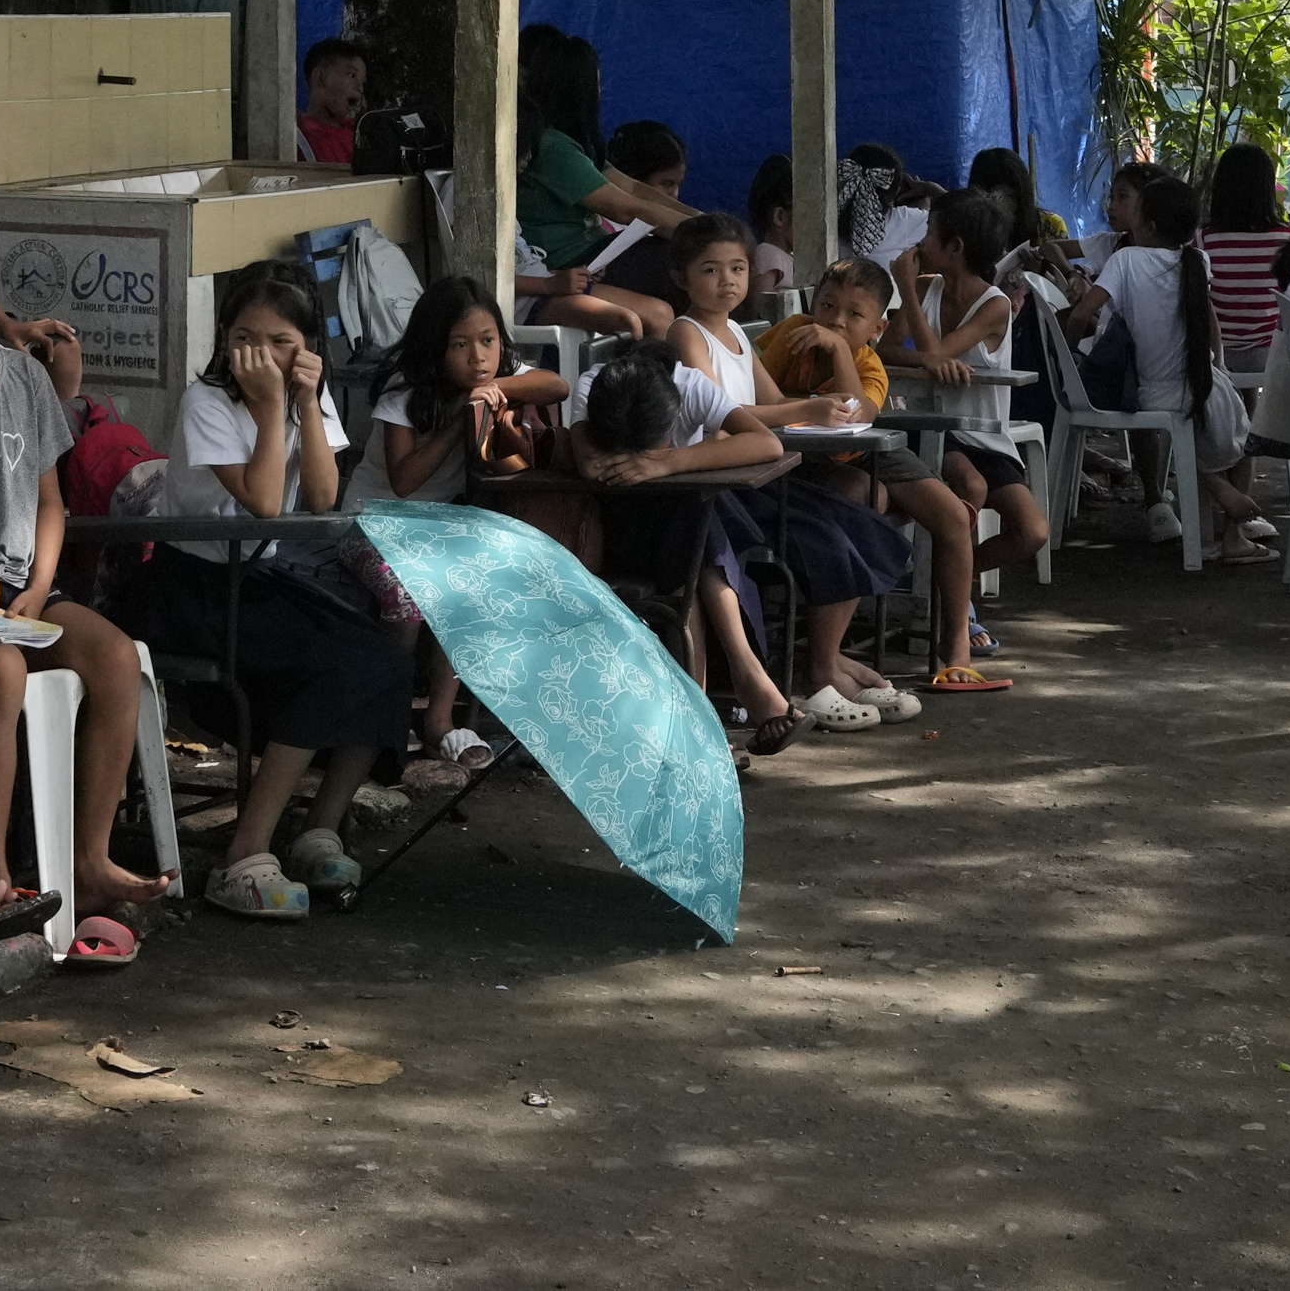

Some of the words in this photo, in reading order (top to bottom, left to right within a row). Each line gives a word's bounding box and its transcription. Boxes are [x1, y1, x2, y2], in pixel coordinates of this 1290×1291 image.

[102, 270, 155, 305] CRS
[70, 301, 106, 314] CATHOLIC
[107, 303, 130, 315] RELIEF
[130, 304, 159, 317] SERVICES
[104, 354, 112, 368] &
[113, 353, 157, 370] HYGIENE
